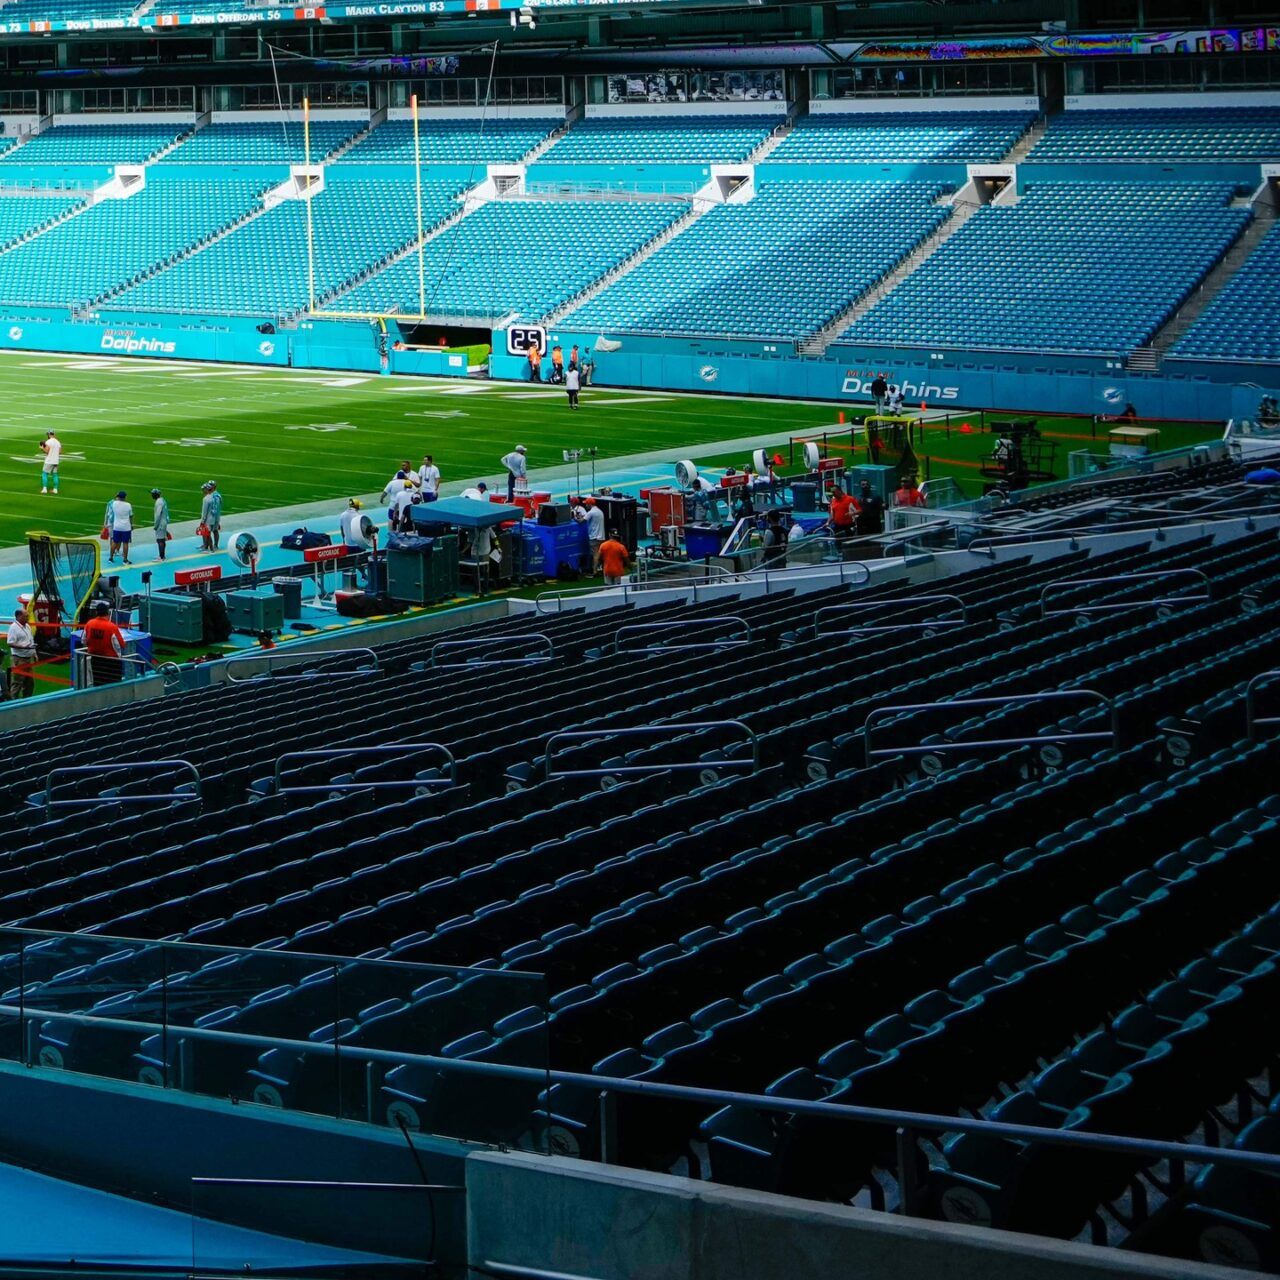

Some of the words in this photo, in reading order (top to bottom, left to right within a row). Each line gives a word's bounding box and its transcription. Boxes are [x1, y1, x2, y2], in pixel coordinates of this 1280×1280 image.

[346, 6, 376, 16] MARK
[380, 4, 425, 15] CLAYTON
[429, 2, 445, 12] 83
[127, 17, 139, 27] 75
[191, 15, 215, 24] JOHN
[267, 11, 281, 20] 56
[10, 23, 21, 32] 73
[100, 336, 176, 353] Dolphins
[514, 330, 539, 350] 25
[318, 548, 340, 558] GATORADE
[190, 570, 213, 580] GATORADE
